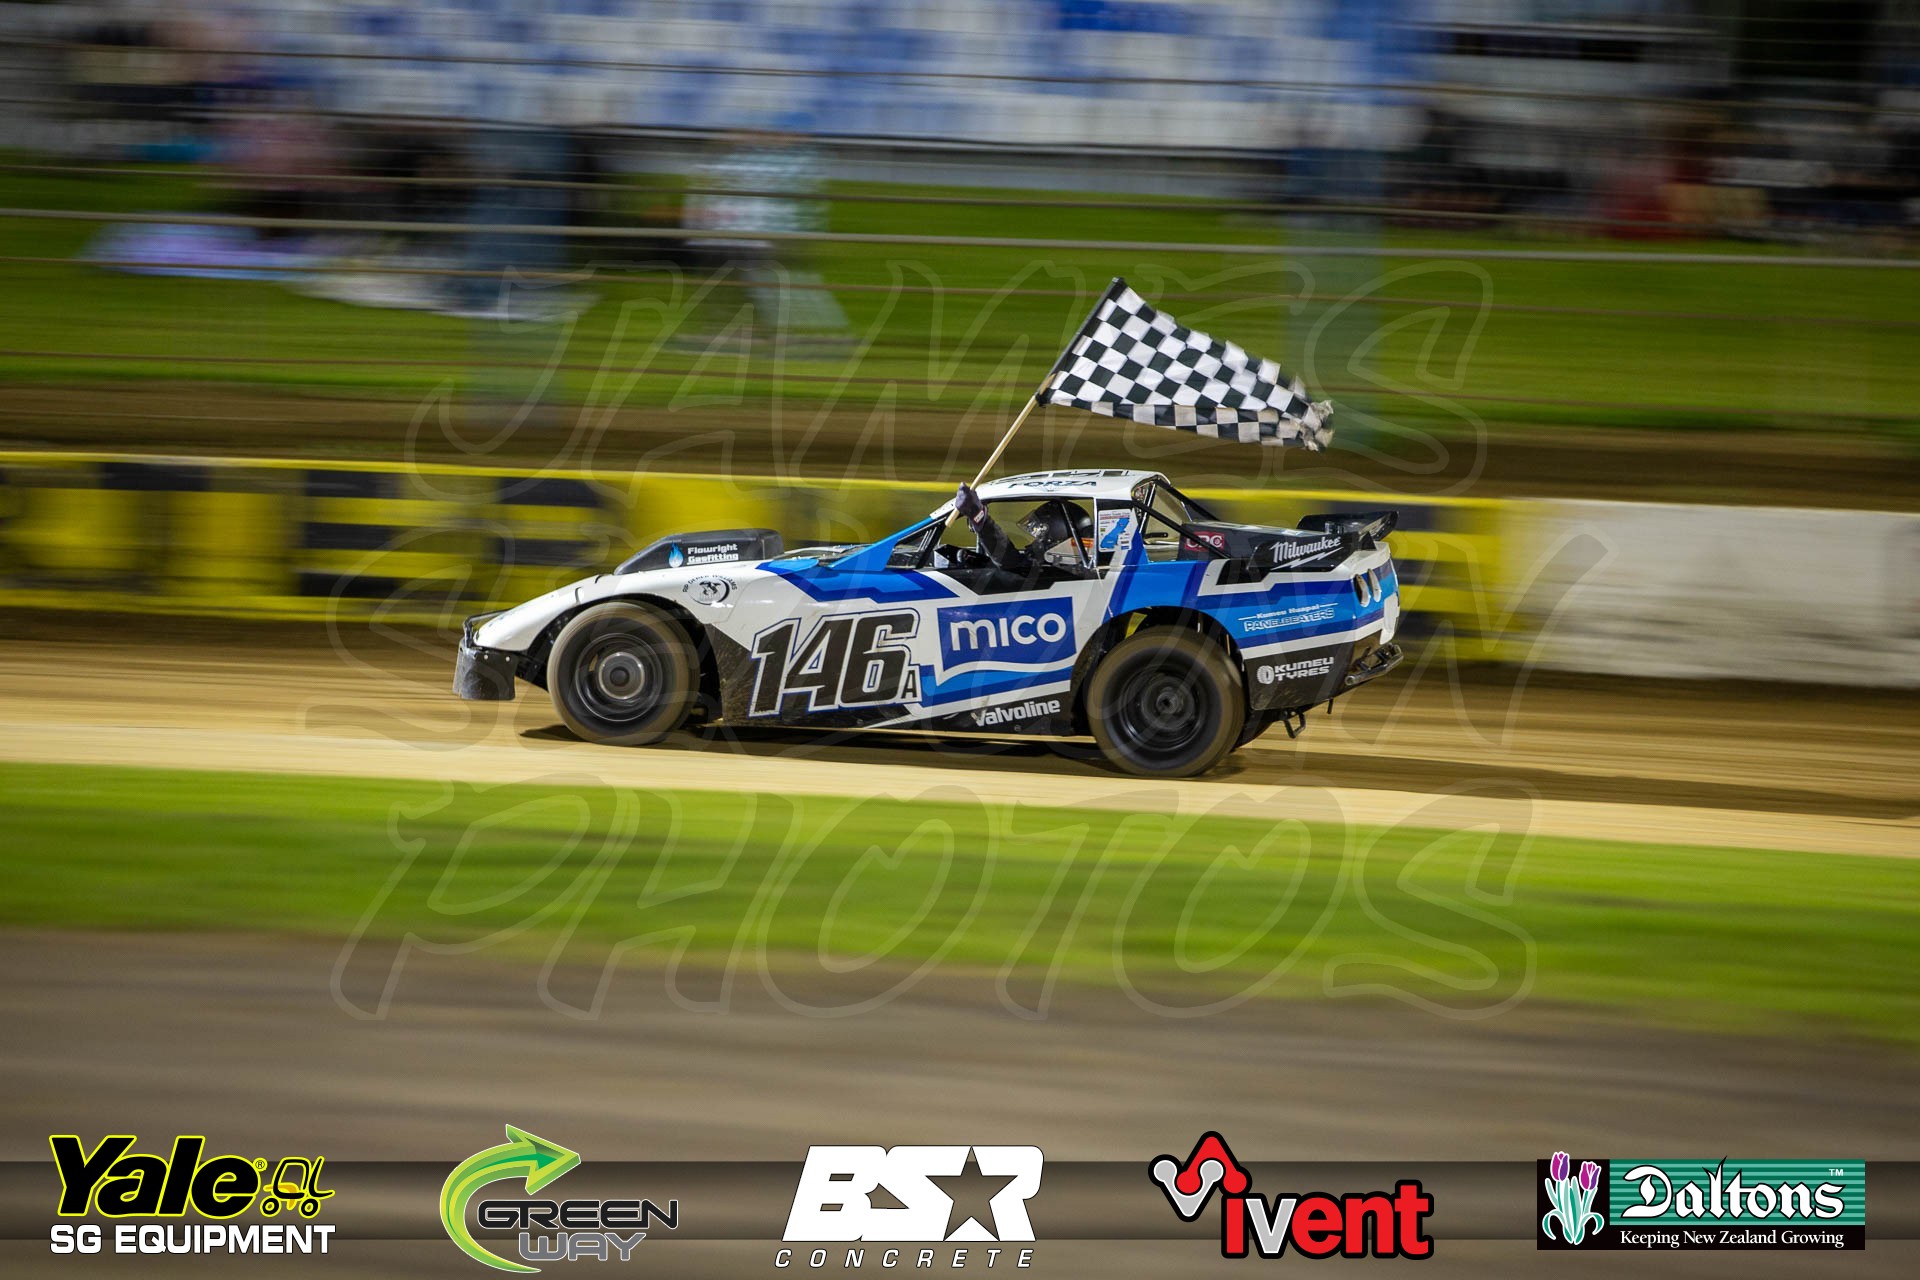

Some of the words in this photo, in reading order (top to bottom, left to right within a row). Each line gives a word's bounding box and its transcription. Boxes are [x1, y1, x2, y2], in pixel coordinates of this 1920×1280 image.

[687, 543, 738, 555] Flowright
[687, 553, 739, 564] Gasfitting
[1270, 535, 1342, 563] Milwaukee
[1243, 608, 1335, 632] PANELBEATERS
[748, 607, 921, 718] 146
[1274, 656, 1335, 674] KUMEU
[1275, 665, 1330, 682] TYRES
[971, 699, 1061, 727] Valvoline
